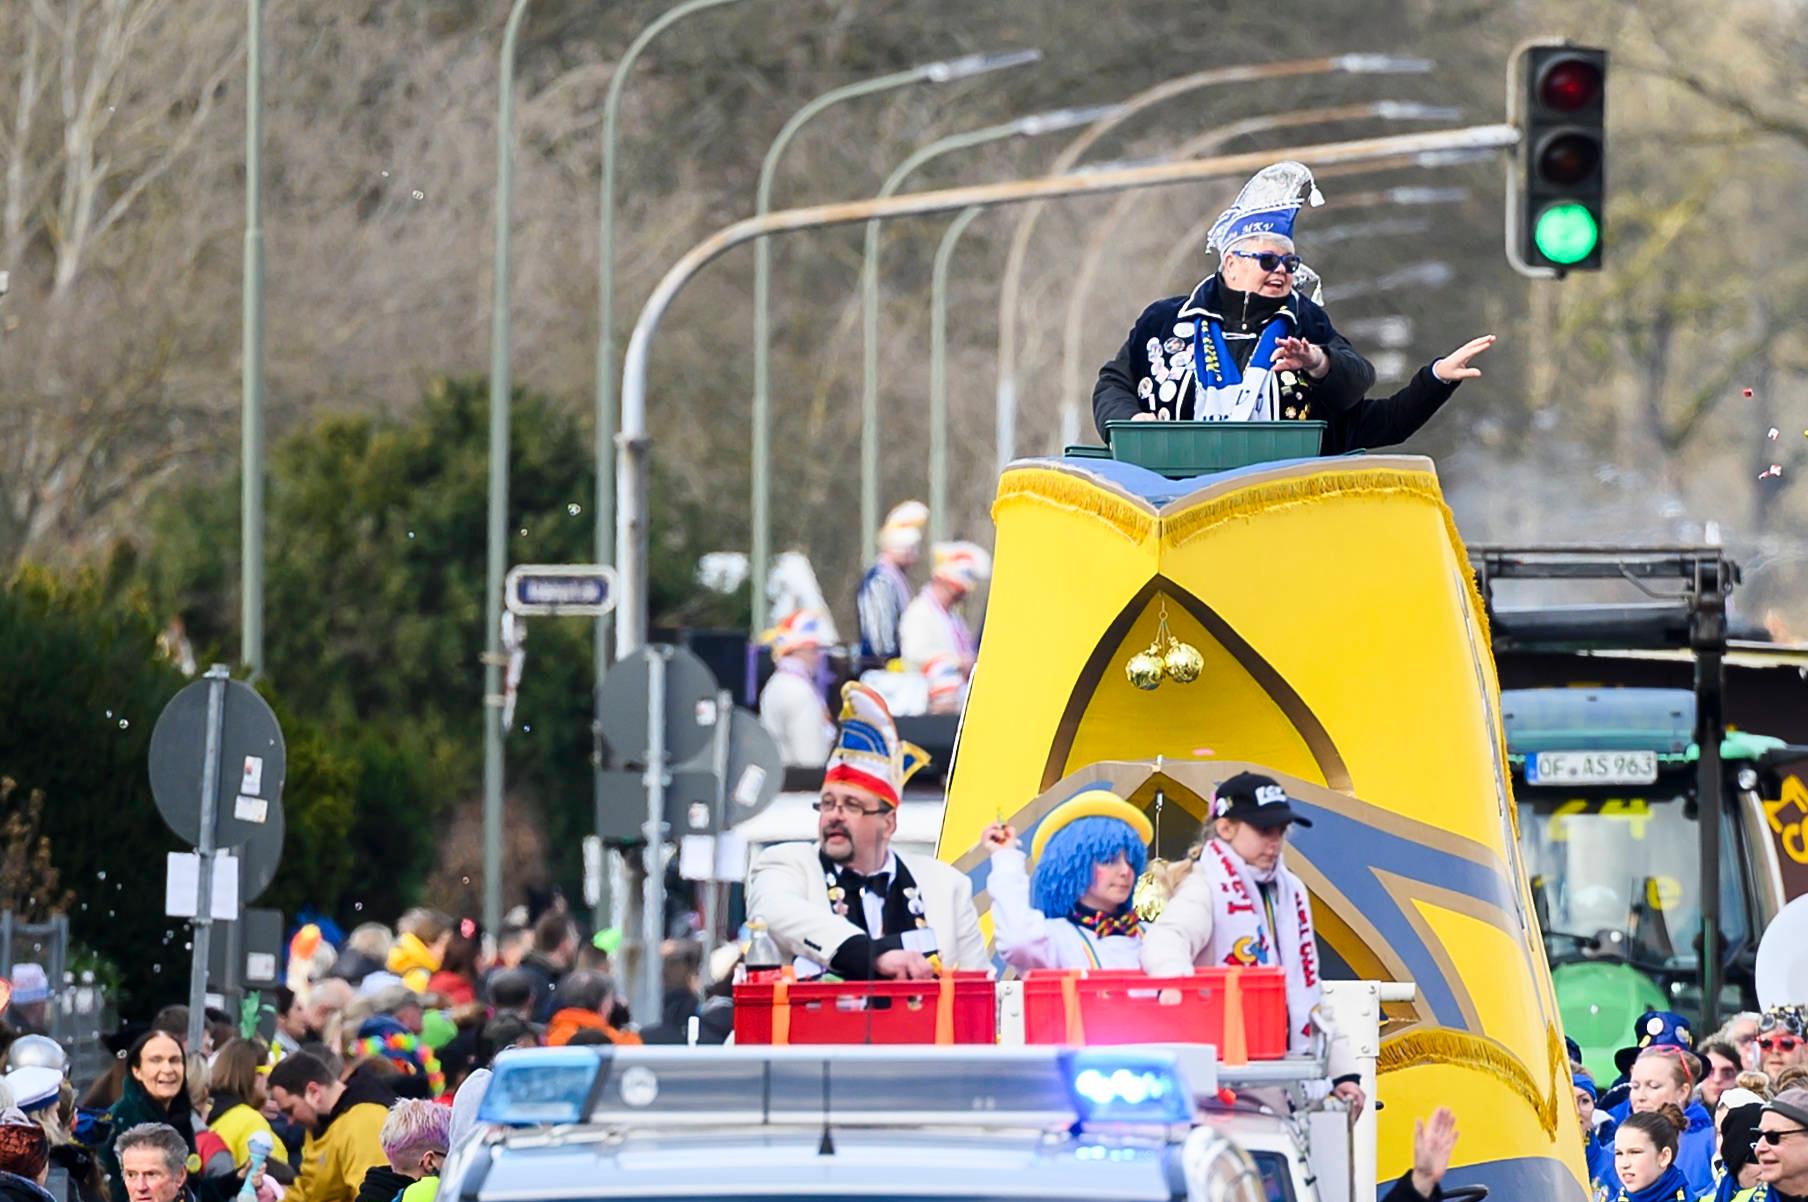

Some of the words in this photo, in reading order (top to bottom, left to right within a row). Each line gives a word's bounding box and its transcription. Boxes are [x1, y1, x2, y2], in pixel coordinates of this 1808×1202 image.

[1540, 757, 1564, 777] OF
[1583, 757, 1608, 776] AS
[1614, 756, 1653, 775] 963
